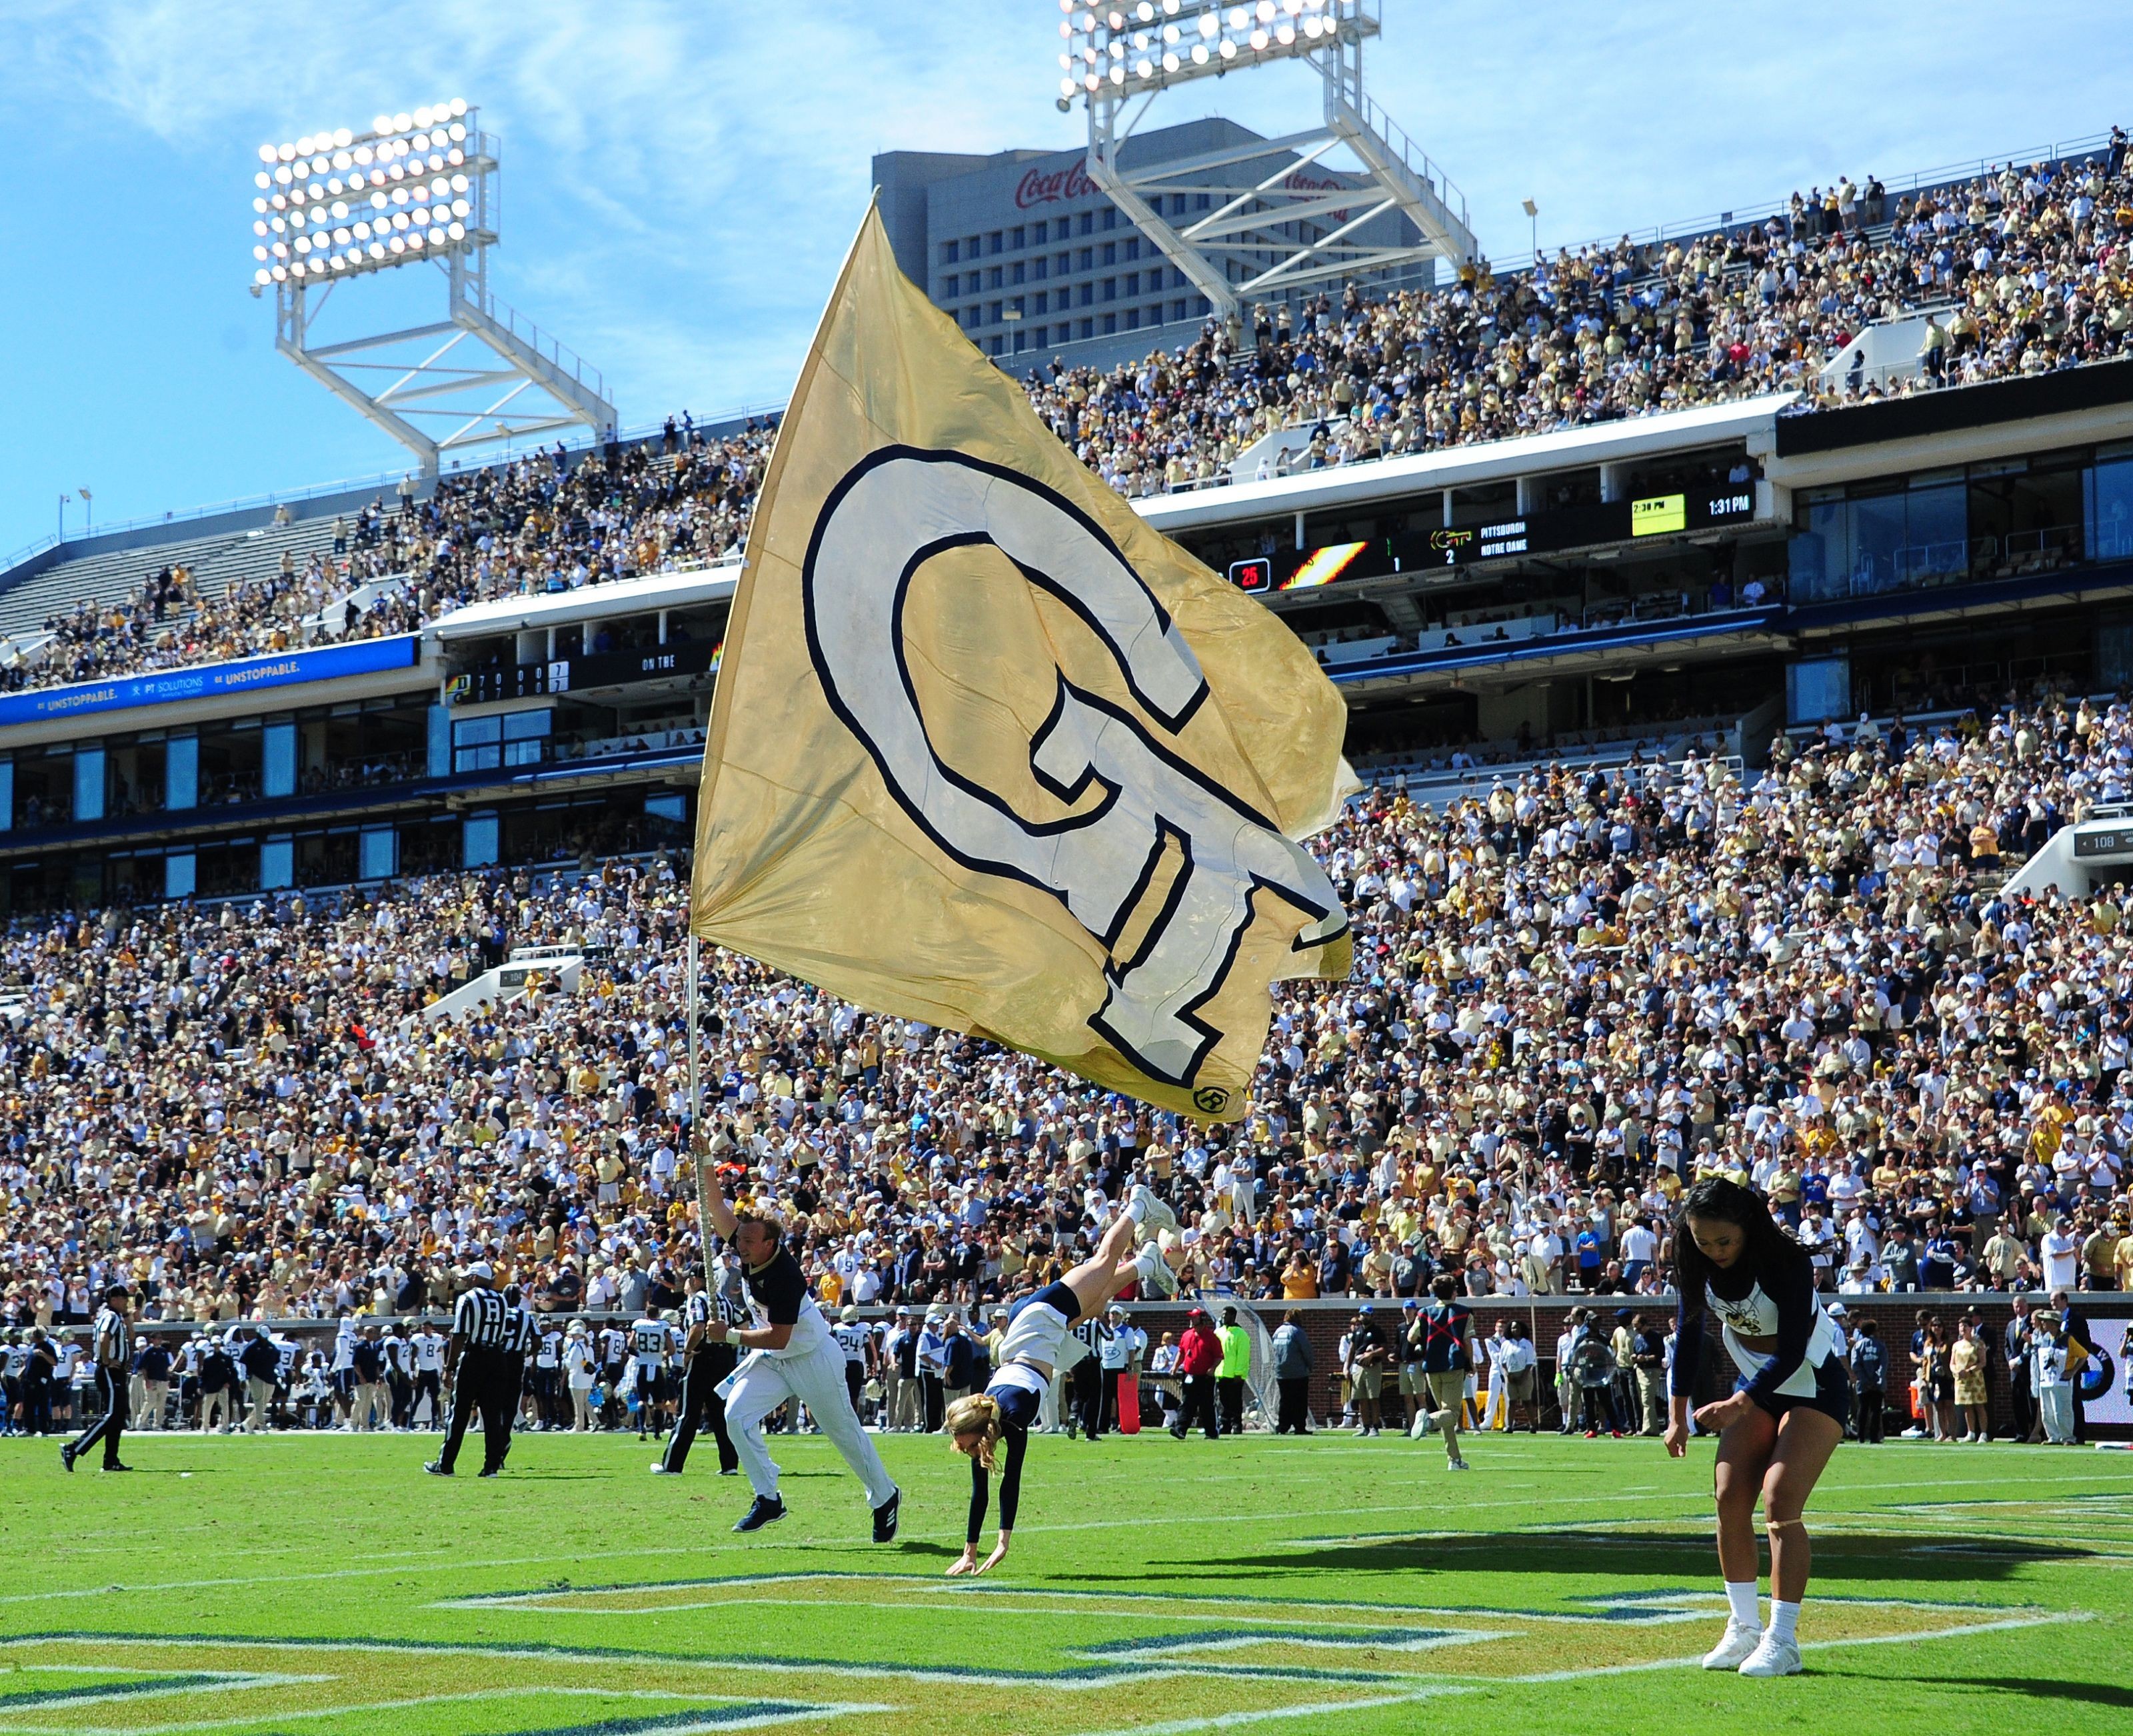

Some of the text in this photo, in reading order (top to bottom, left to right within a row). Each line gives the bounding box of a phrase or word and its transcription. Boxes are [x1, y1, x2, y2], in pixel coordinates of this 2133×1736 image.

[1709, 495, 1750, 515] 1:31 PM
[1480, 521, 1526, 539] PITTSBURGH
[1446, 549, 1454, 564] 2
[1480, 539, 1528, 557] NOTRE DAME
[1242, 566, 1258, 586] 25
[642, 657, 655, 671] ON
[226, 661, 300, 685] UNSTOPPABLE.
[145, 683, 155, 693] PT
[158, 676, 203, 693] SOLUTIONS
[48, 689, 117, 711] UNSTOPPABLE.
[2094, 836, 2114, 849] 108
[845, 1261, 853, 1272] 9
[427, 1344, 435, 1357] 8
[638, 1333, 661, 1353] 83
[840, 1335, 859, 1352] 24
